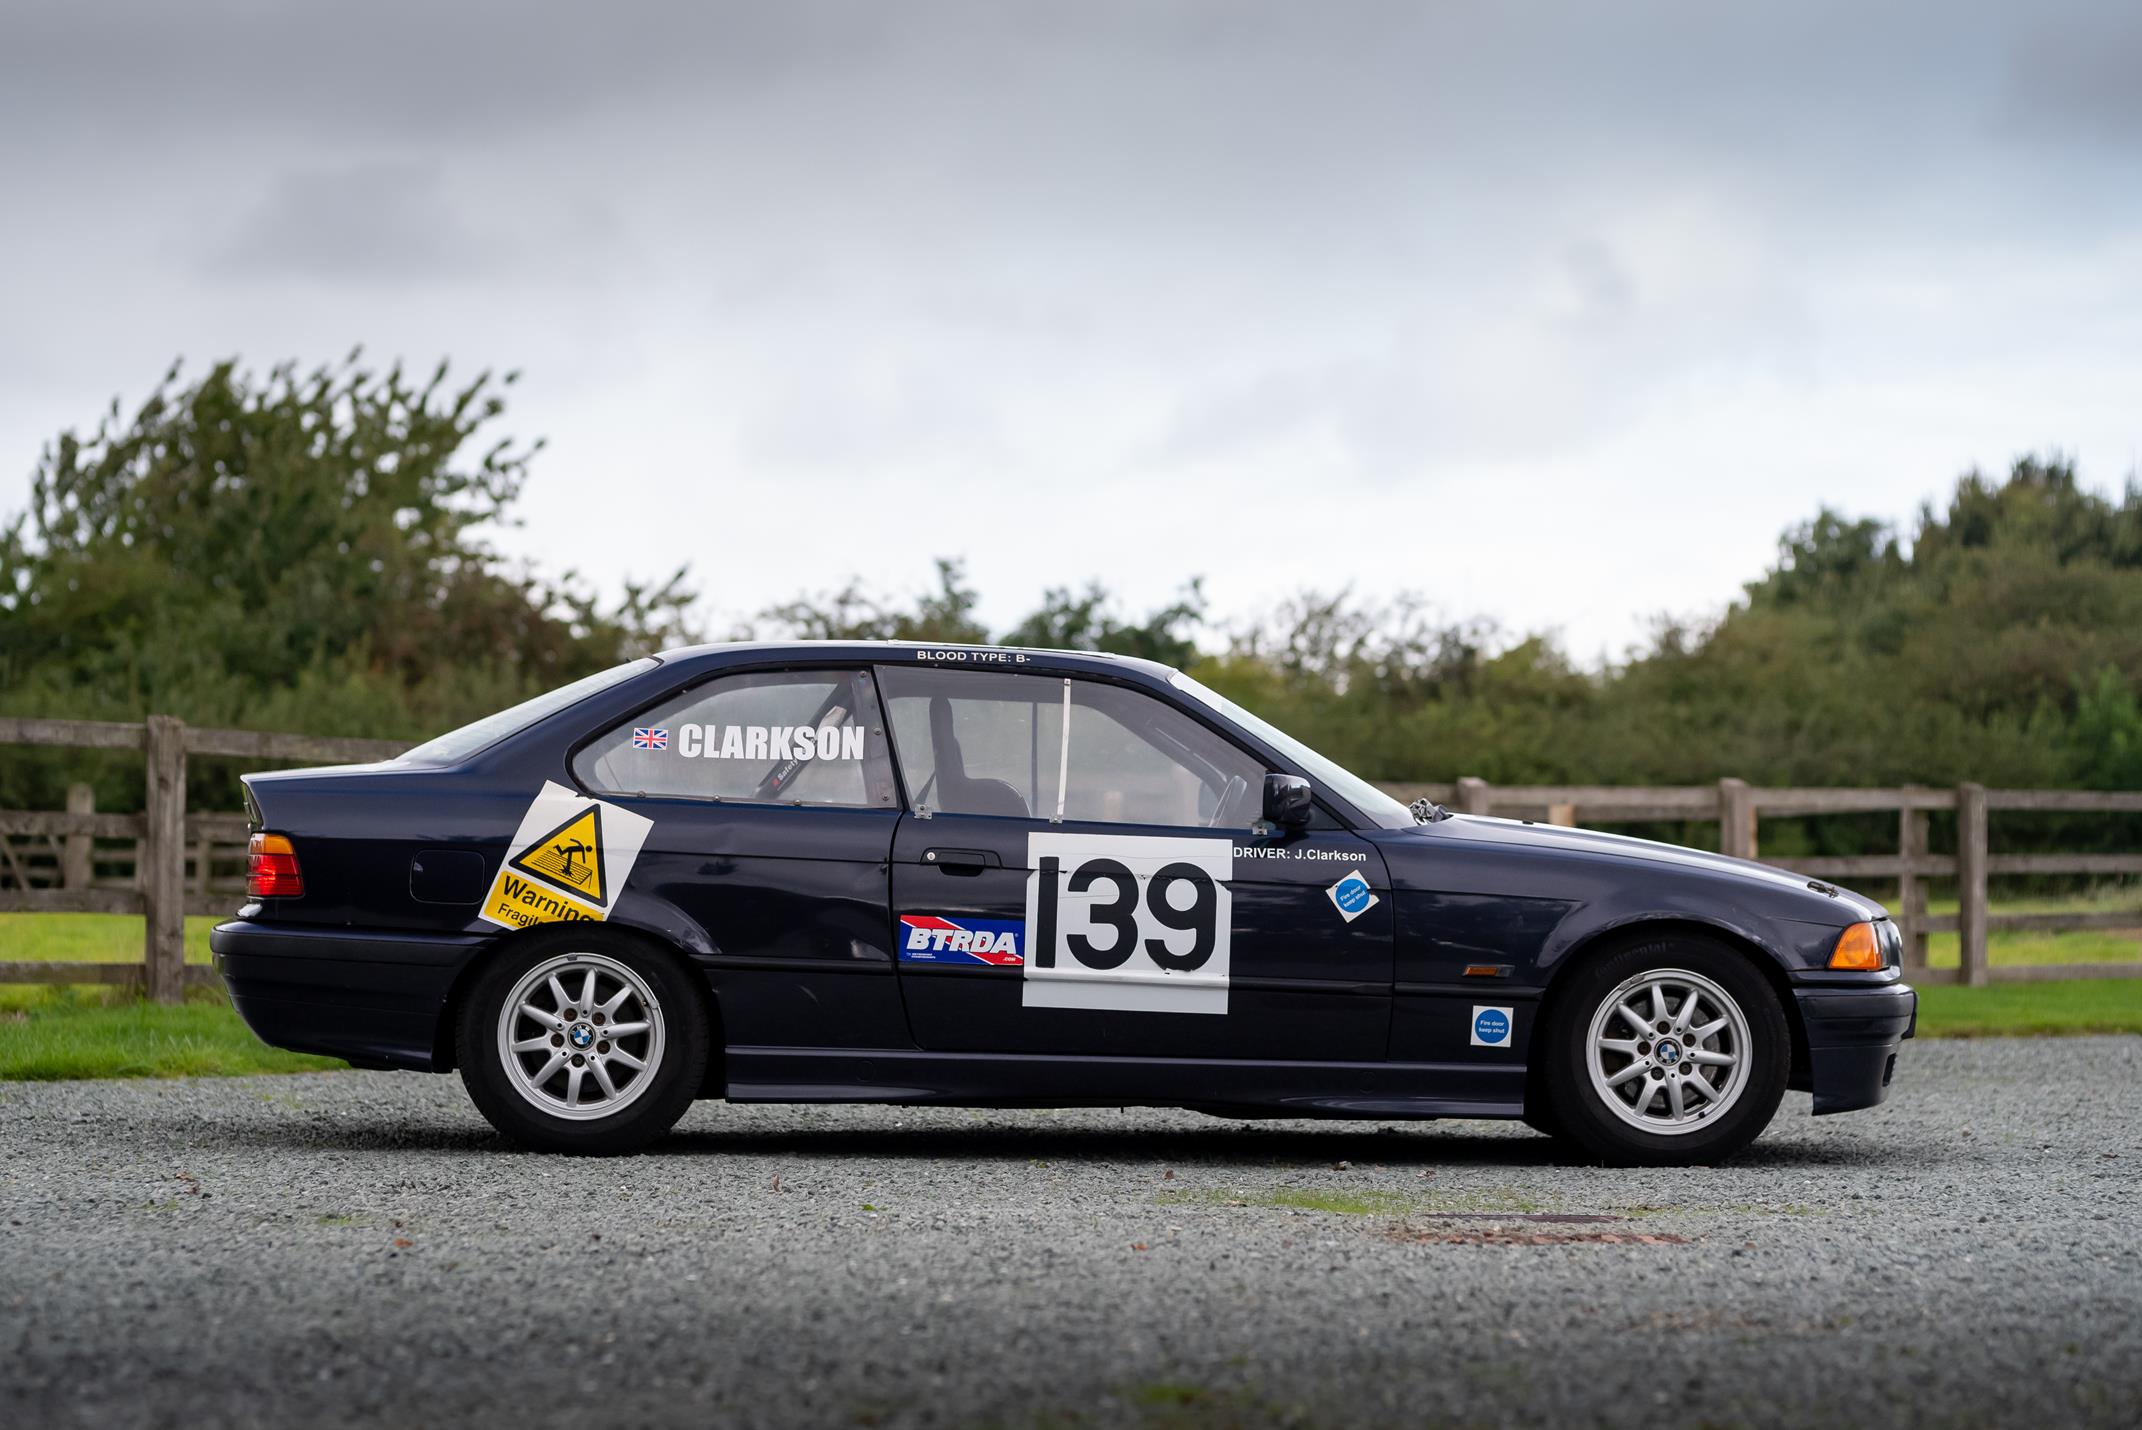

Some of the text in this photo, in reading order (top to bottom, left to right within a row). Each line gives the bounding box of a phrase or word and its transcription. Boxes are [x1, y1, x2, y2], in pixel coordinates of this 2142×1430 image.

[917, 650, 1031, 663] BLOOD TYPE: B-
[678, 723, 865, 761] CLARKSON
[777, 758, 798, 781] Safety
[1233, 847, 1367, 861] DRIVER: J.Clarkson
[497, 903, 541, 927] Fragil
[1035, 856, 1217, 972] 139
[906, 927, 1017, 955] BTRDA
